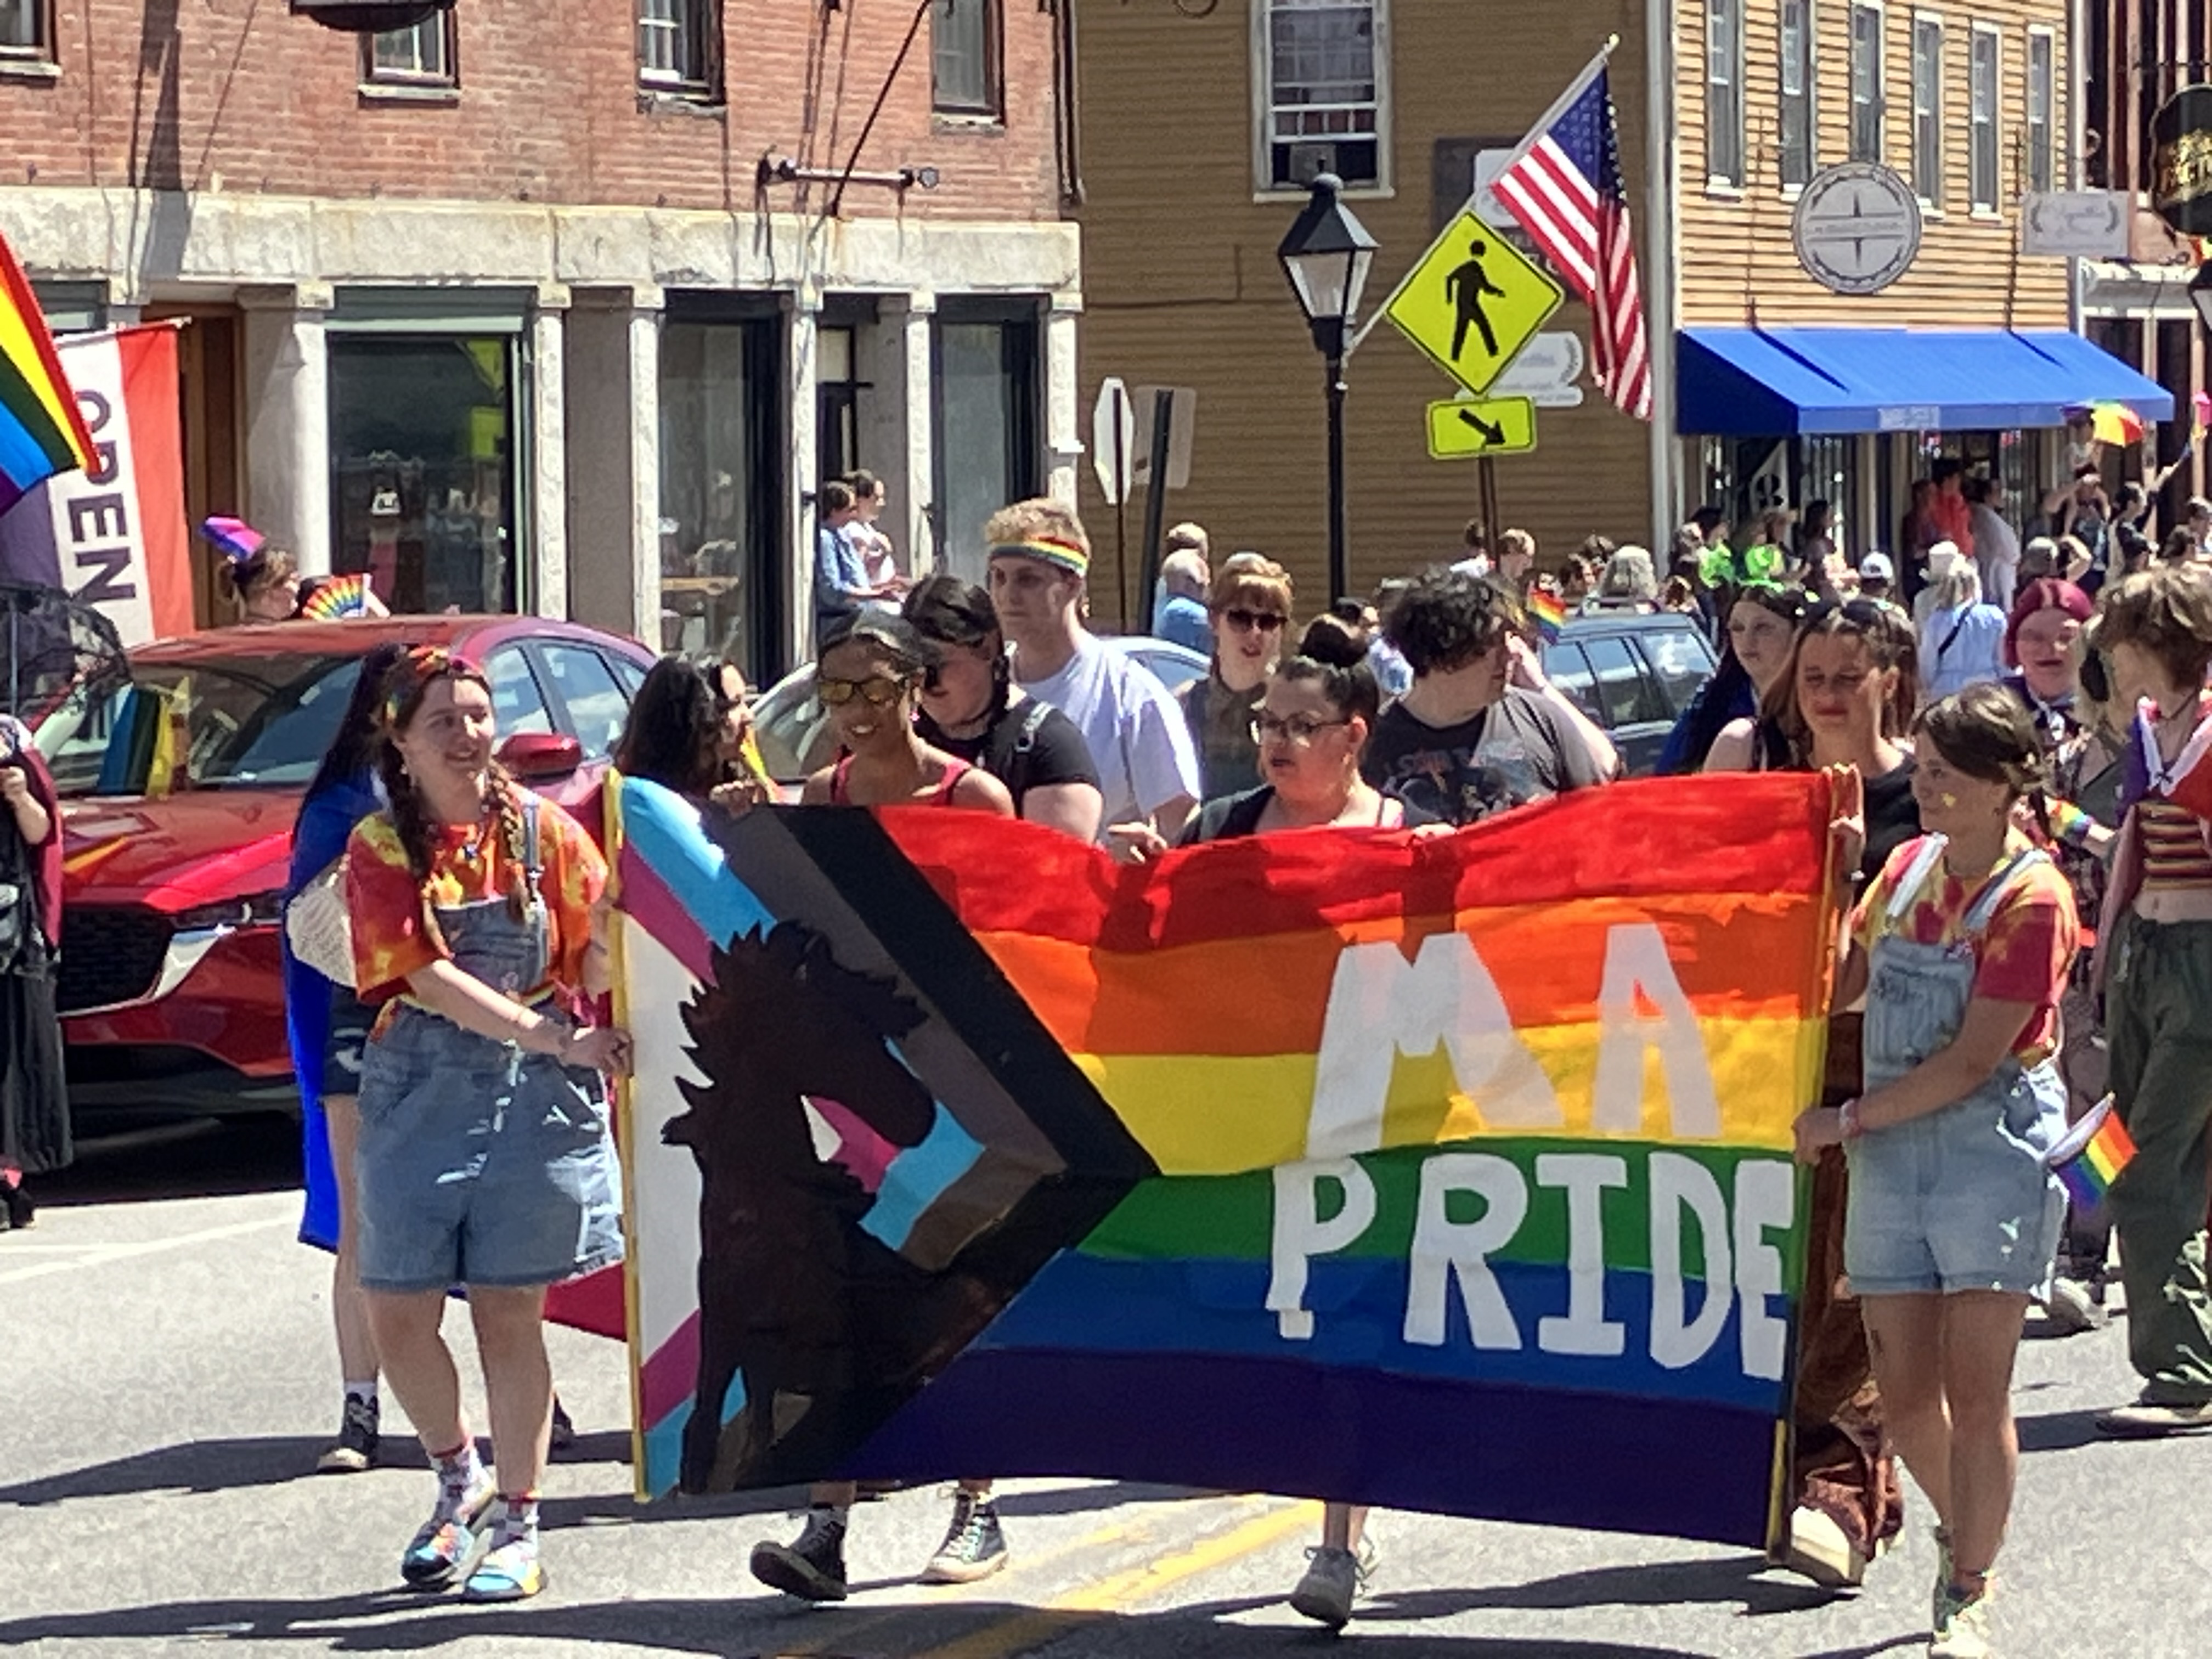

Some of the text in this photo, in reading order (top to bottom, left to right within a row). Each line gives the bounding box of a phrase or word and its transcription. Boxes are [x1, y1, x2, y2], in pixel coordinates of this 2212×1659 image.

[70, 390, 136, 602] OPEN
[1305, 924, 1723, 1158] MA
[1265, 1152, 1794, 1380] PRIDE
